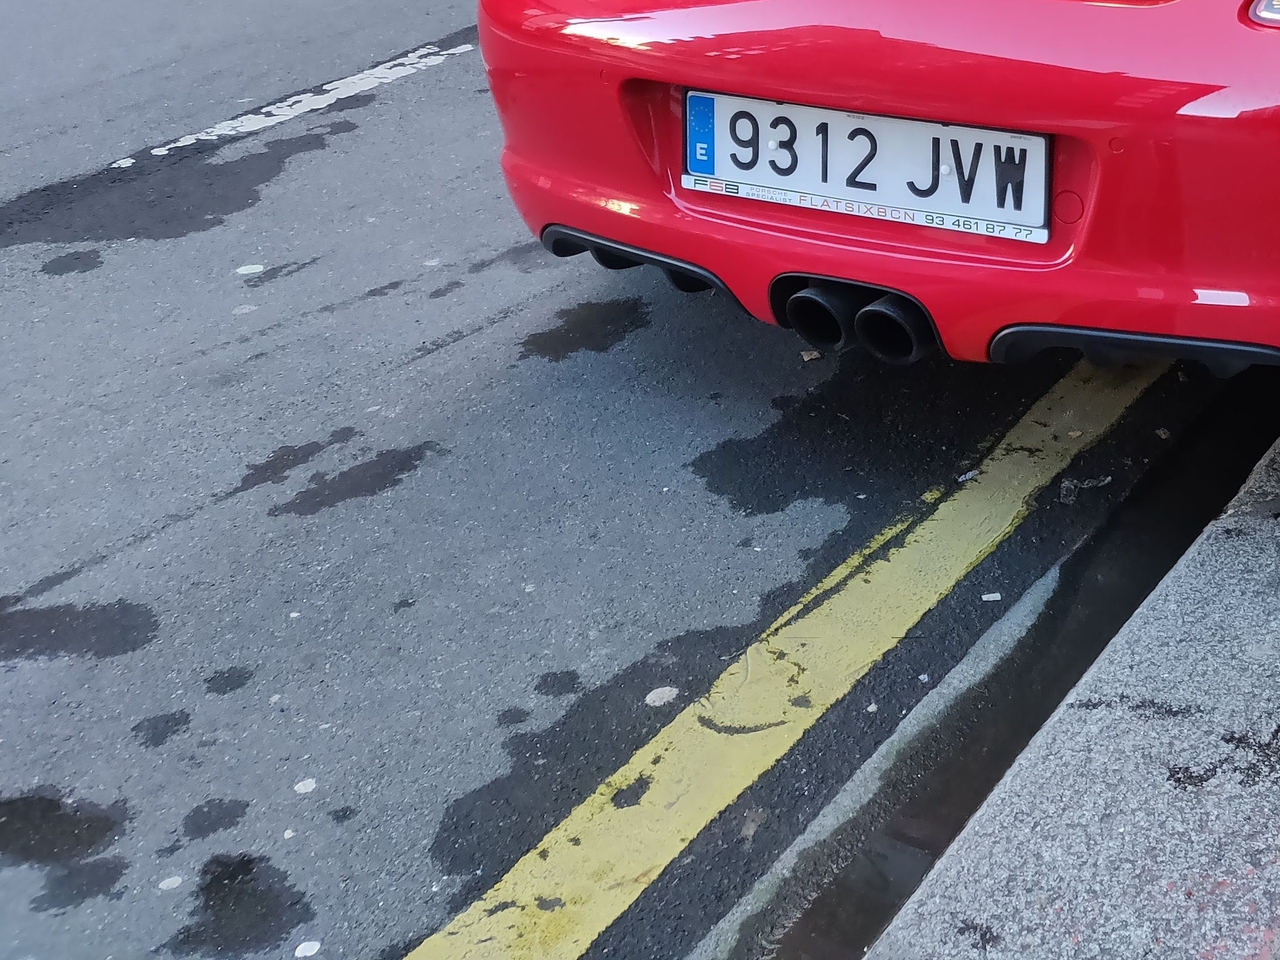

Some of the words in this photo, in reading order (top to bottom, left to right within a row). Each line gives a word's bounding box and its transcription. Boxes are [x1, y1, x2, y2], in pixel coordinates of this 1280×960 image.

[695, 142, 709, 162] E
[728, 109, 878, 192] 9312
[905, 135, 1028, 212] JVW
[745, 191, 793, 204] SPECIALIST
[749, 186, 788, 197] PORSCHE
[799, 195, 916, 222] FLATSIXBCN
[924, 214, 945, 226] 93
[951, 218, 980, 232] 461
[985, 223, 1006, 235] 87
[1011, 226, 1034, 239] 77
